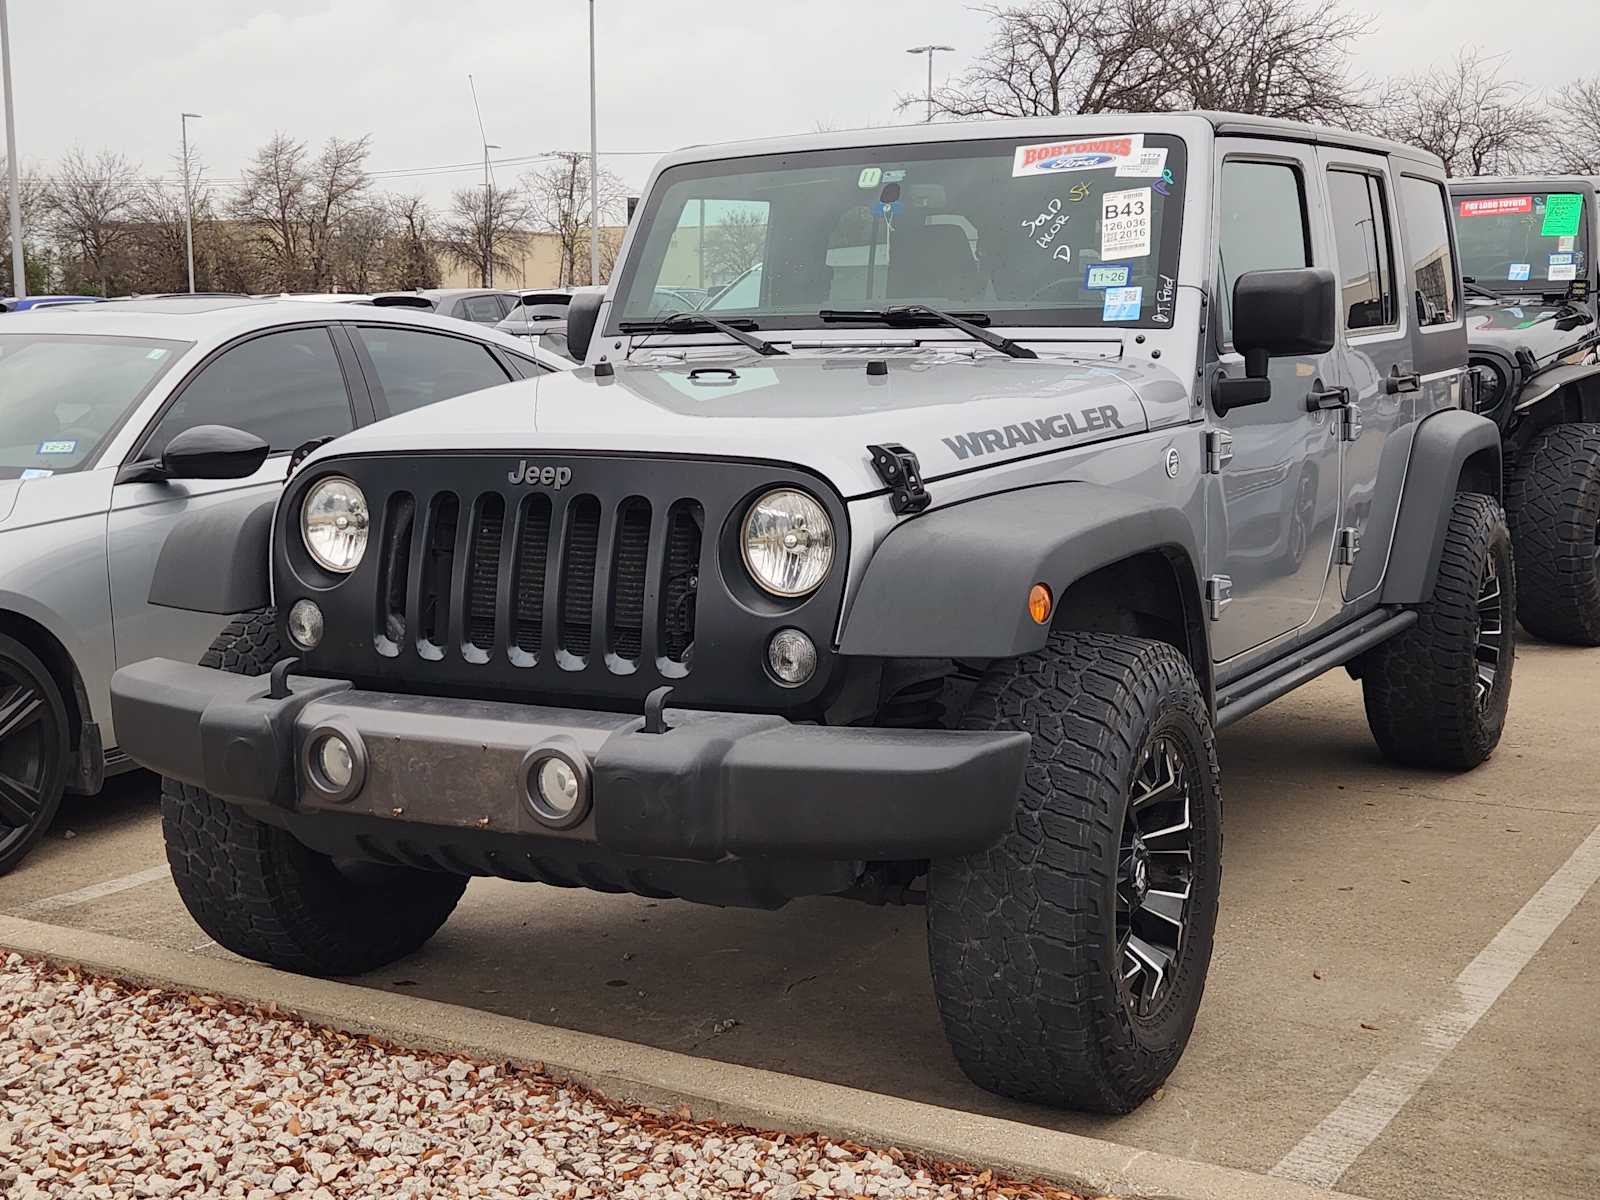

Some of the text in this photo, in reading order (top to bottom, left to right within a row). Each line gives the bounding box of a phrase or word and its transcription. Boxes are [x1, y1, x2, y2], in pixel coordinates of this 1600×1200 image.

[1051, 155, 1100, 169] Ford
[1021, 198, 1062, 238] SOLD
[1105, 201, 1145, 220] B43
[1104, 219, 1146, 232] 126,036
[1119, 228, 1146, 240] 2016
[1092, 271, 1126, 283] 11-26
[941, 405, 1125, 460] WRANGLER
[508, 459, 573, 491] Jeep
